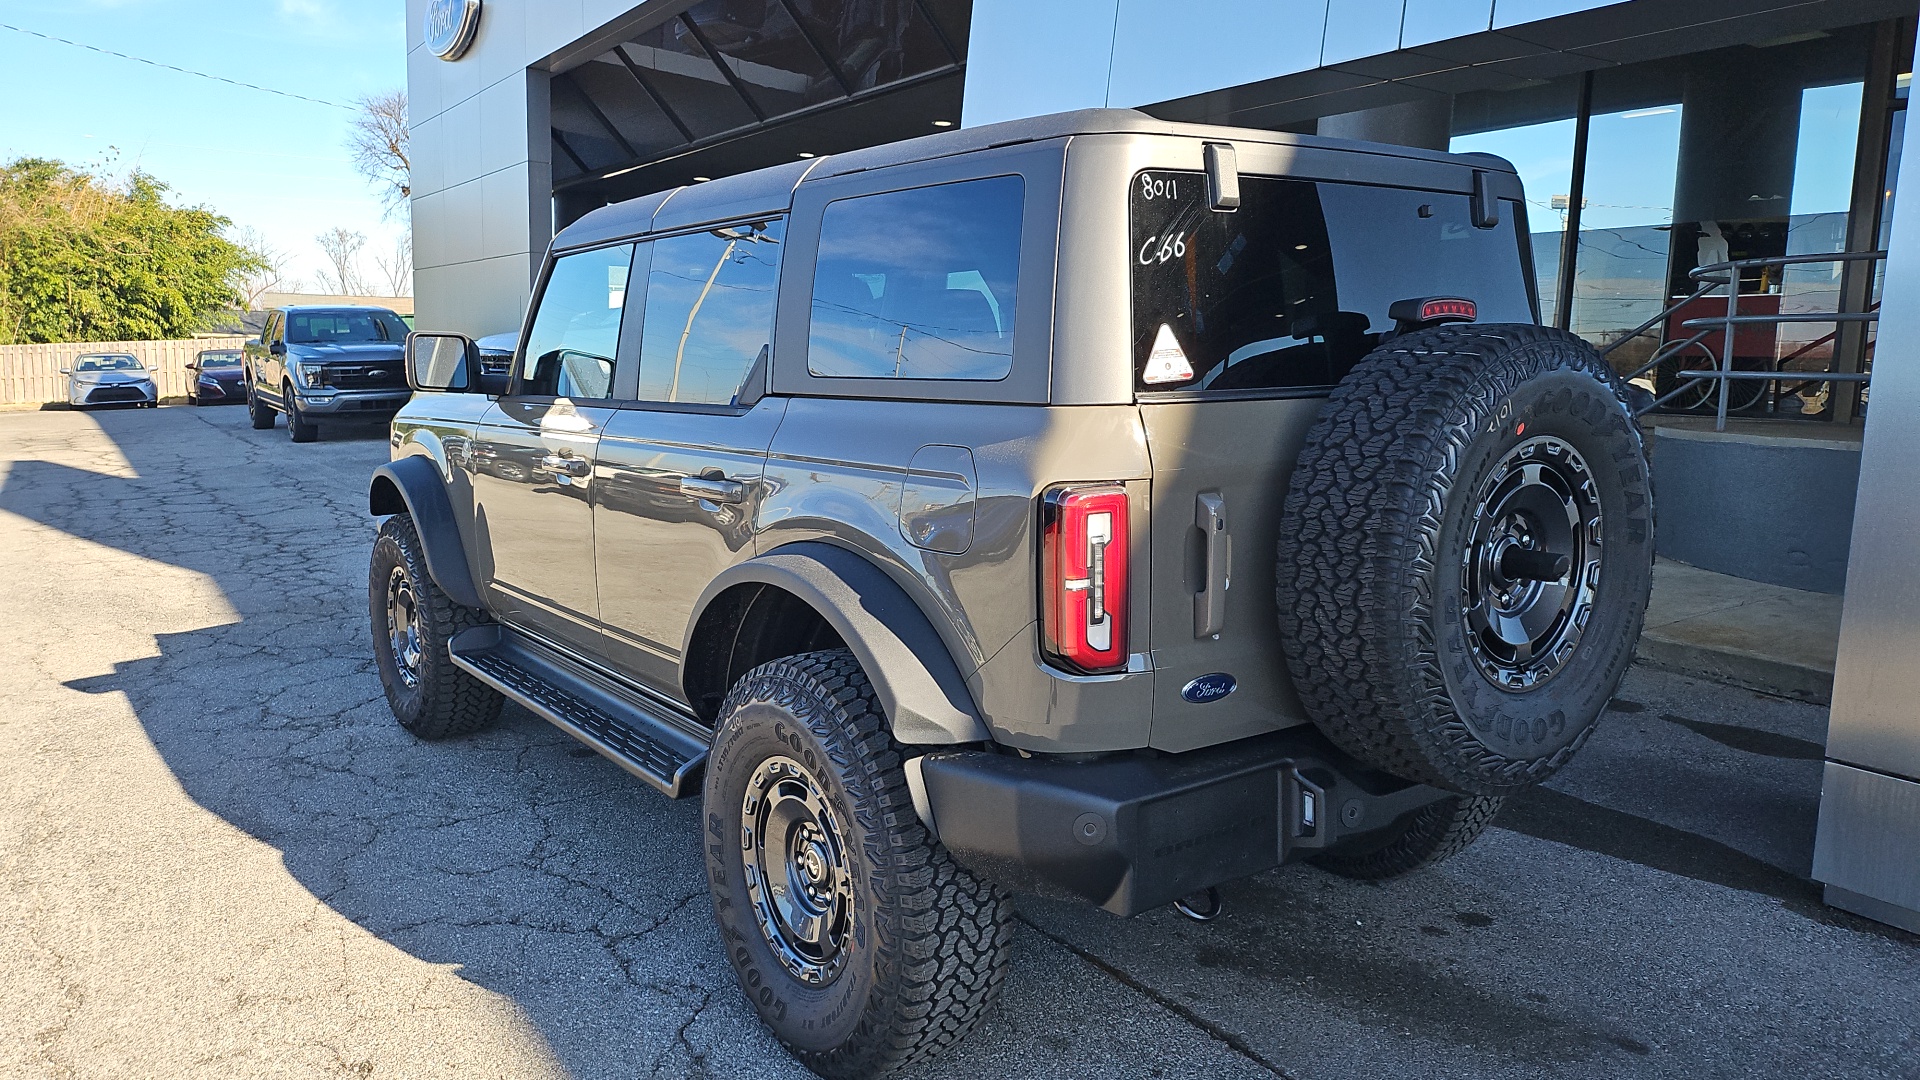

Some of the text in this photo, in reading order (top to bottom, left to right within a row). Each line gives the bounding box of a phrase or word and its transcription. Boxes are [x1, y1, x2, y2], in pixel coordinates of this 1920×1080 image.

[1141, 173, 1177, 200] 8011
[1196, 682, 1226, 698] Ford
[708, 811, 788, 1022] GOODYEAR
